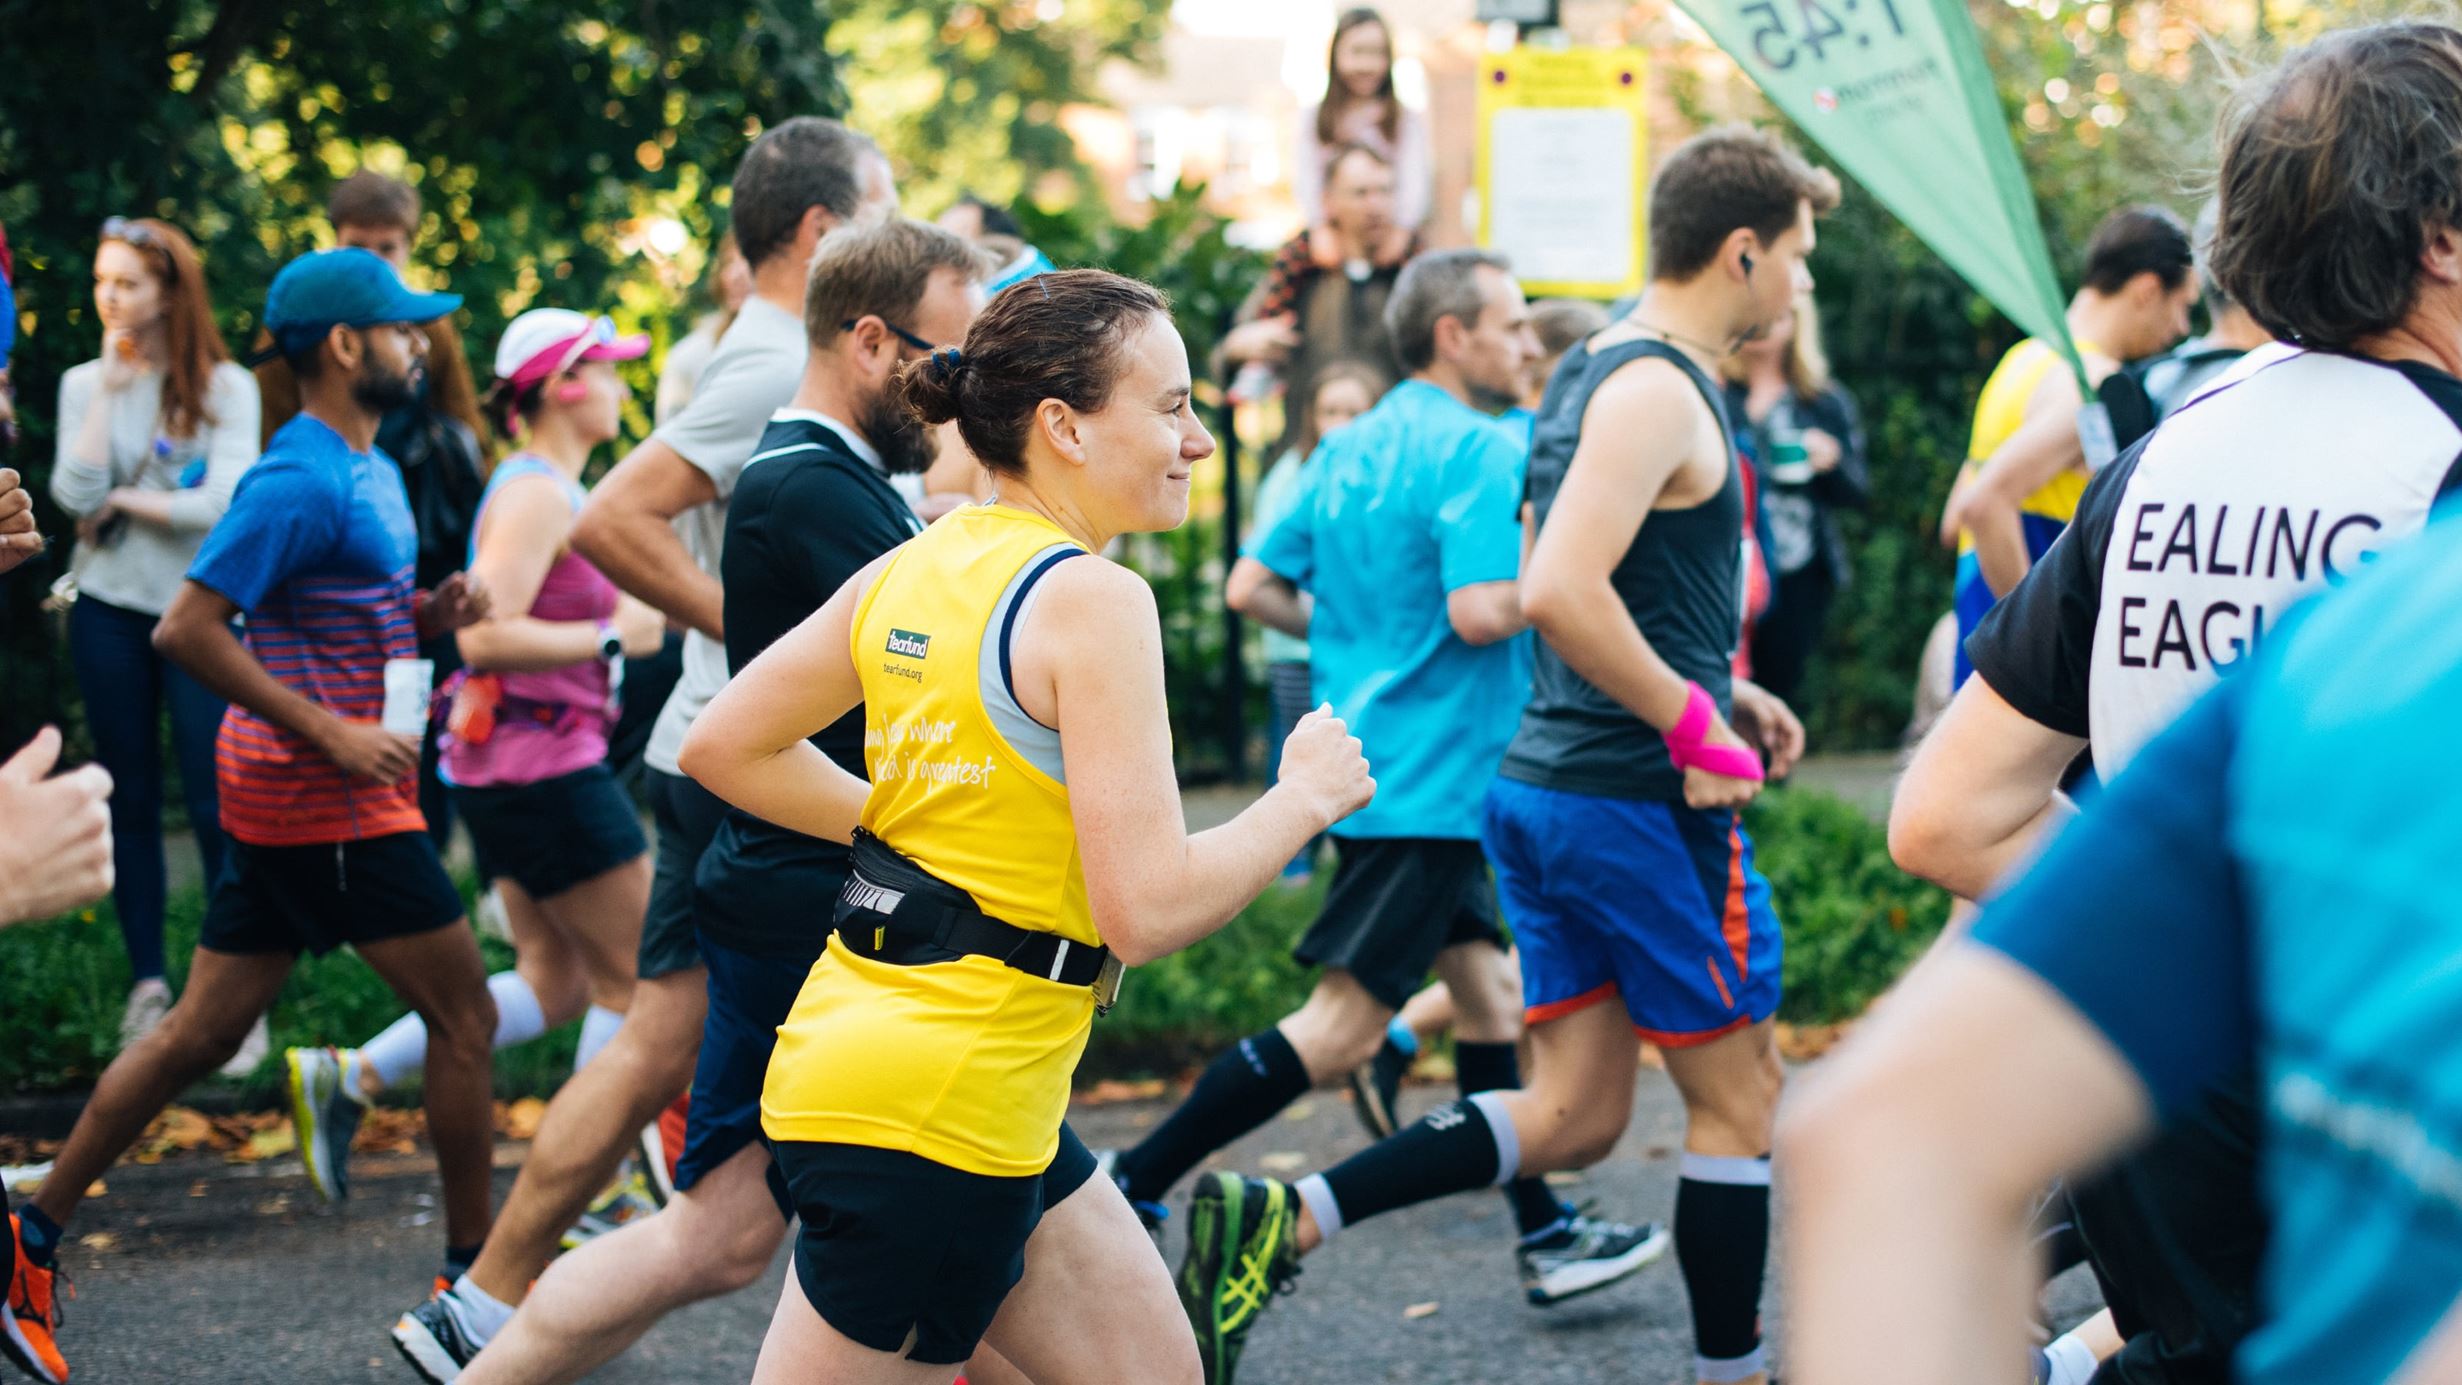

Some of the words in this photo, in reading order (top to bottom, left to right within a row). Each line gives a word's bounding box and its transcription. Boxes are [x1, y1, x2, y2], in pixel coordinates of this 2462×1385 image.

[2127, 503, 2382, 587] EALING
[887, 630, 929, 658] tearfund
[883, 663, 923, 684] tearfund.org
[920, 755, 997, 796] greatest
